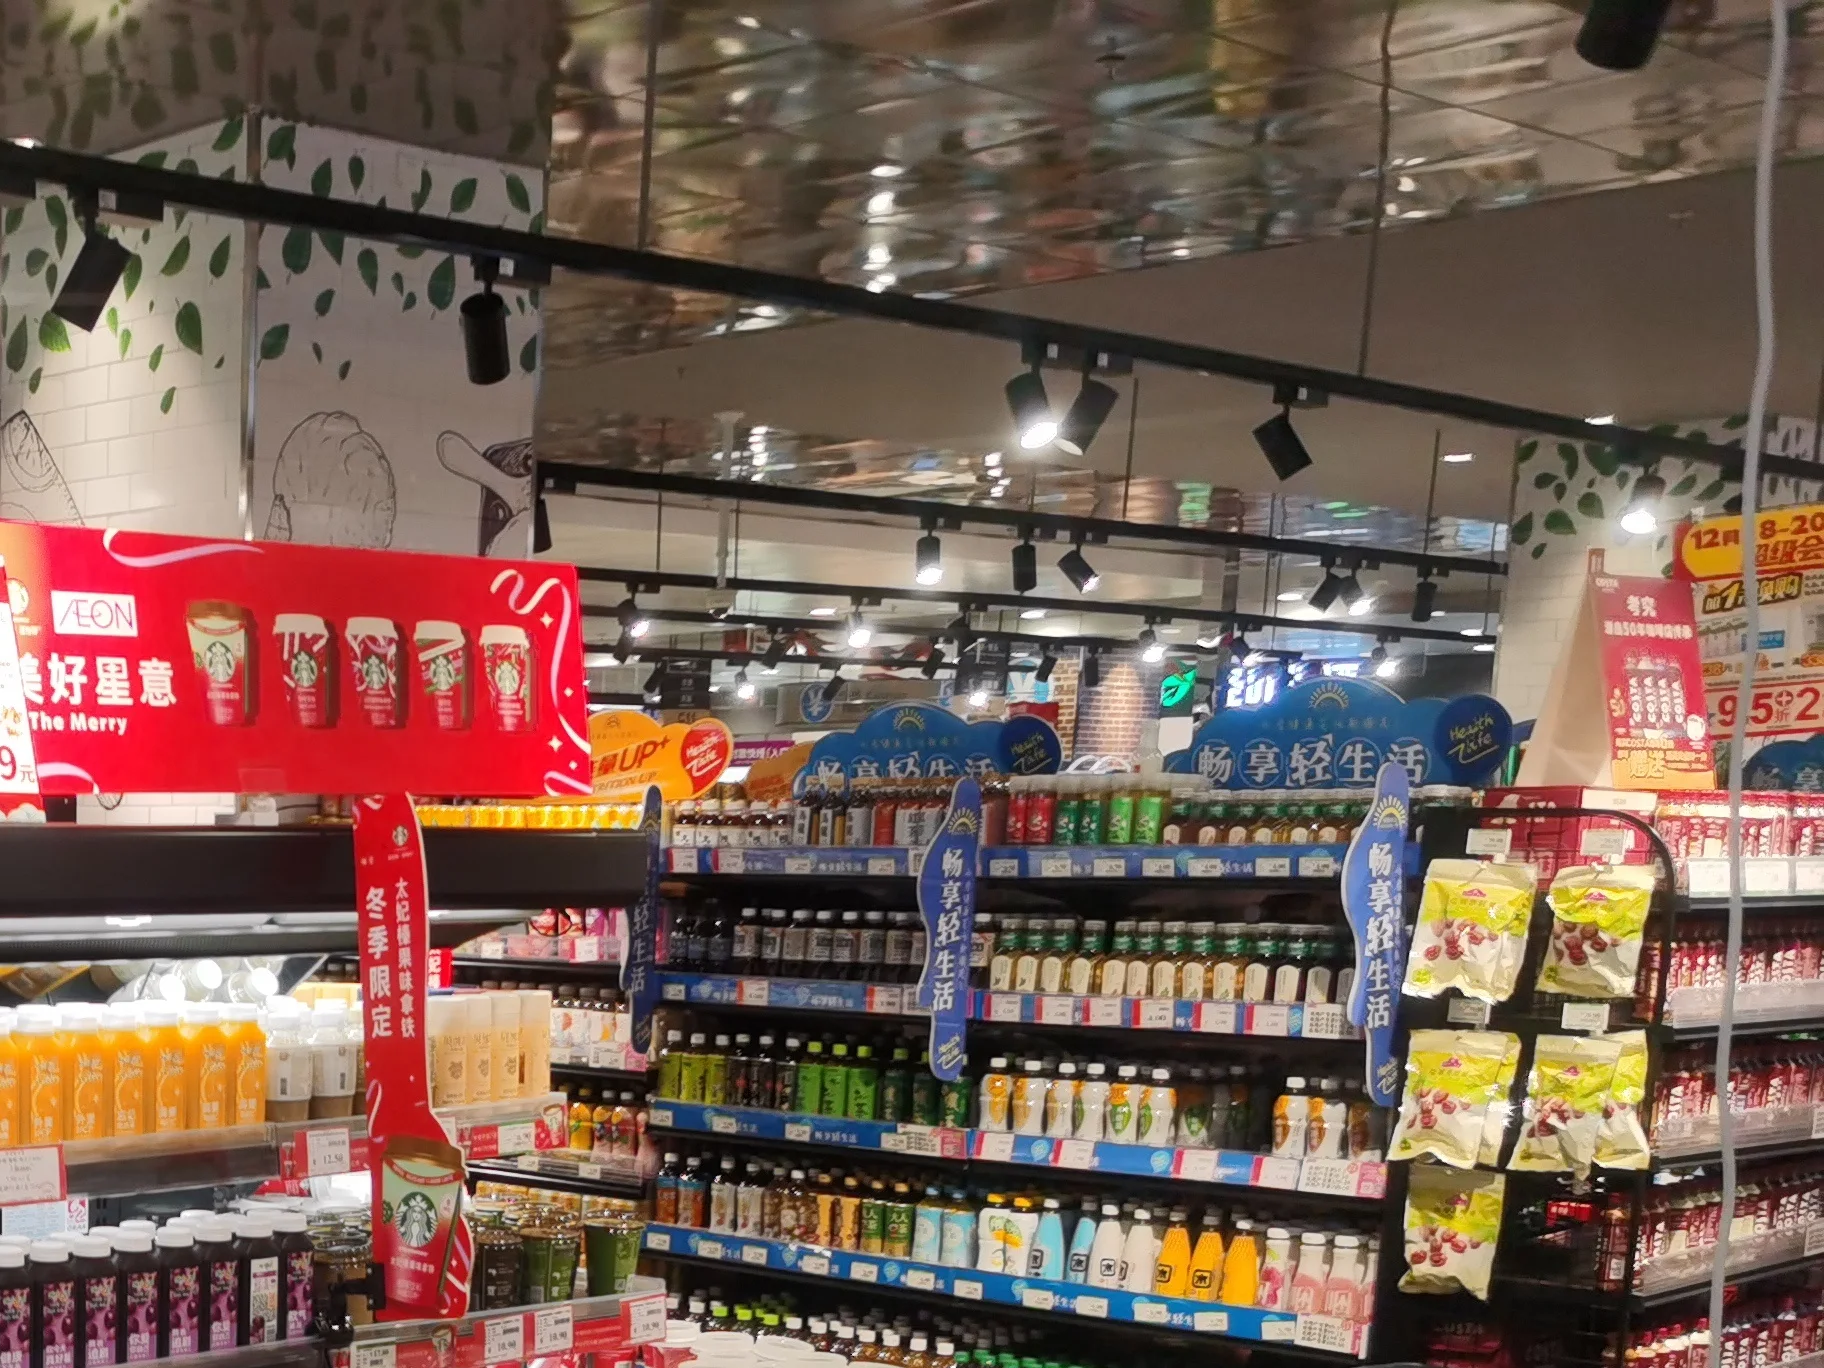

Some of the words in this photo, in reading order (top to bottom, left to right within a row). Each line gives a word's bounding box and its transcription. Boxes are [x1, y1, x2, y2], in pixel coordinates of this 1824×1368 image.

[29, 714, 66, 732] The
[72, 715, 126, 735] Merry
[365, 886, 394, 1039] 冬季限定
[932, 848, 964, 1012] 畅享轻生活
[1364, 842, 1396, 1027] 畅享轻生活
